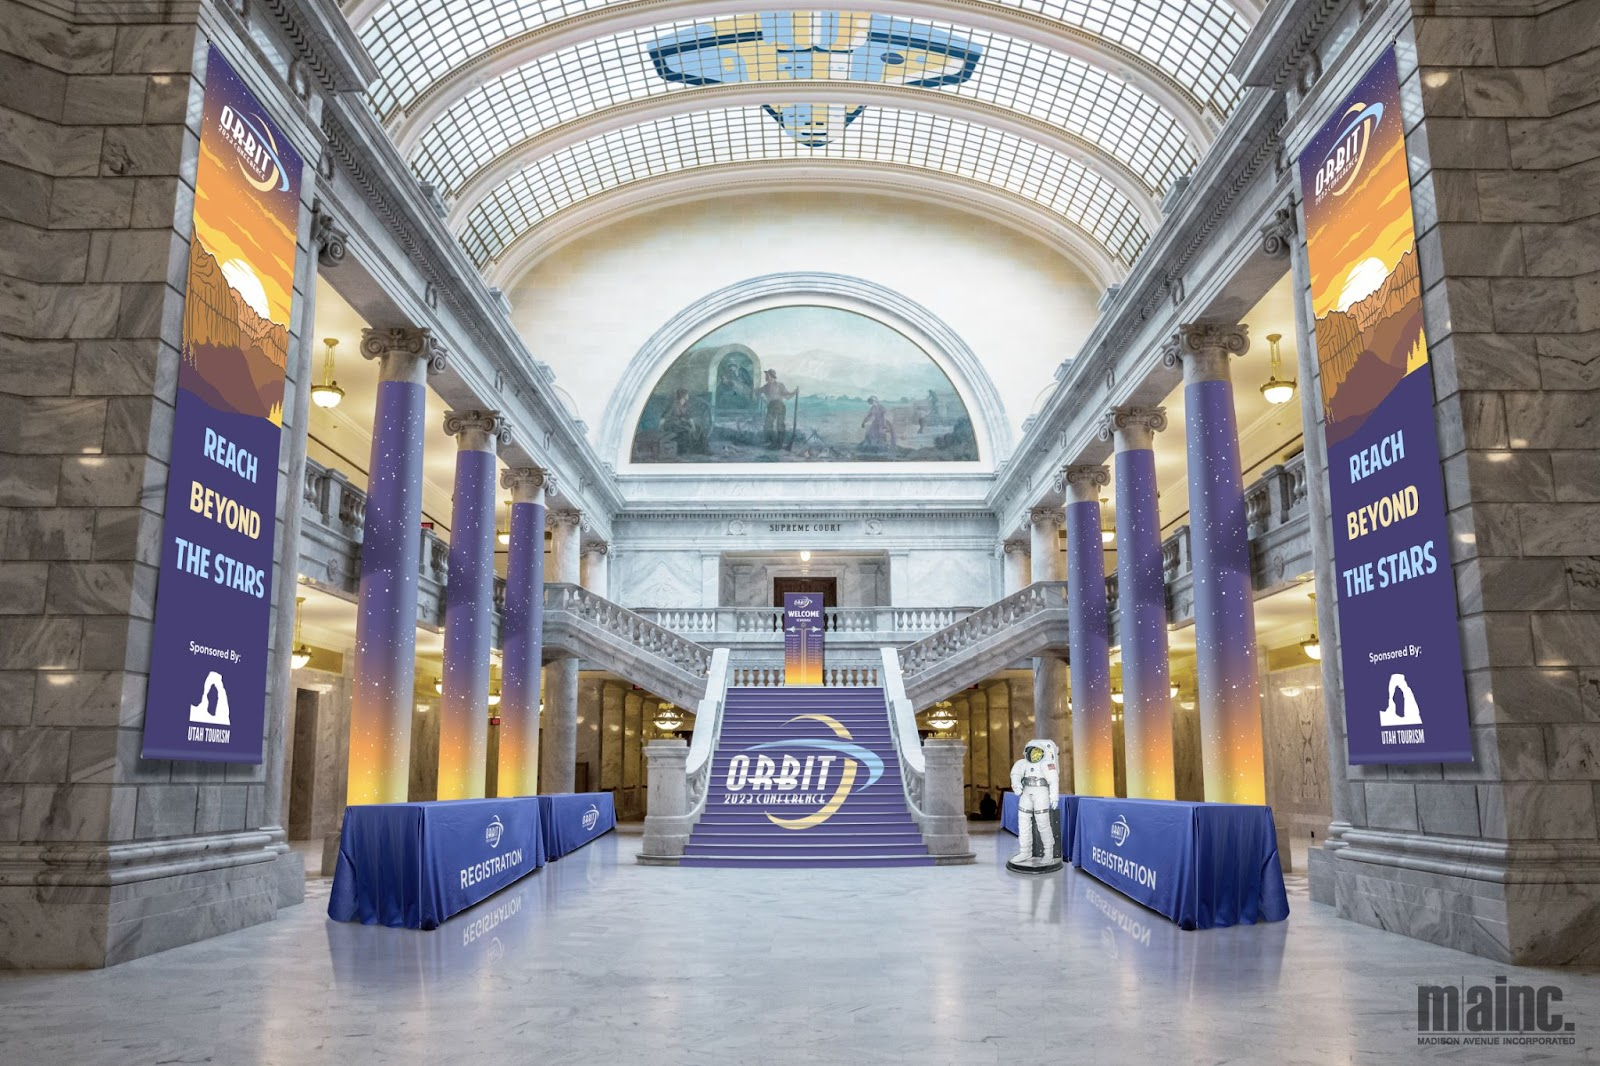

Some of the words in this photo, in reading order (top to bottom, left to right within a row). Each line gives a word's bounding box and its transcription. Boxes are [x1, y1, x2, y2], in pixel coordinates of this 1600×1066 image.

[220, 105, 271, 172] ORBIT
[1315, 125, 1360, 196] ORBIT
[203, 427, 258, 483] REACH
[1349, 429, 1405, 484] REACH
[189, 480, 261, 540] BEYOND
[769, 524, 809, 532] SUPREME
[813, 524, 841, 532] COURT
[1346, 485, 1419, 541] BEYOND
[175, 536, 211, 580] THE
[214, 553, 265, 599] STARS
[1343, 562, 1375, 598] THE
[1377, 540, 1437, 589] STARS
[787, 610, 820, 618] WELCOME
[189, 640, 229, 660] Sponsored
[230, 650, 241, 664] By:
[1368, 645, 1408, 665] Sponsored
[1409, 644, 1422, 658] By:
[187, 726, 204, 742] UTAH
[205, 727, 231, 744] TOURISM
[1381, 730, 1397, 745] UTAH
[1397, 729, 1425, 744] TOURISM
[725, 754, 837, 791] ORBIT
[723, 793, 754, 805] 2023
[755, 793, 826, 805] CONFERENCE
[460, 848, 523, 890] REGISTRATION
[1092, 846, 1157, 890] REGISTRATION
